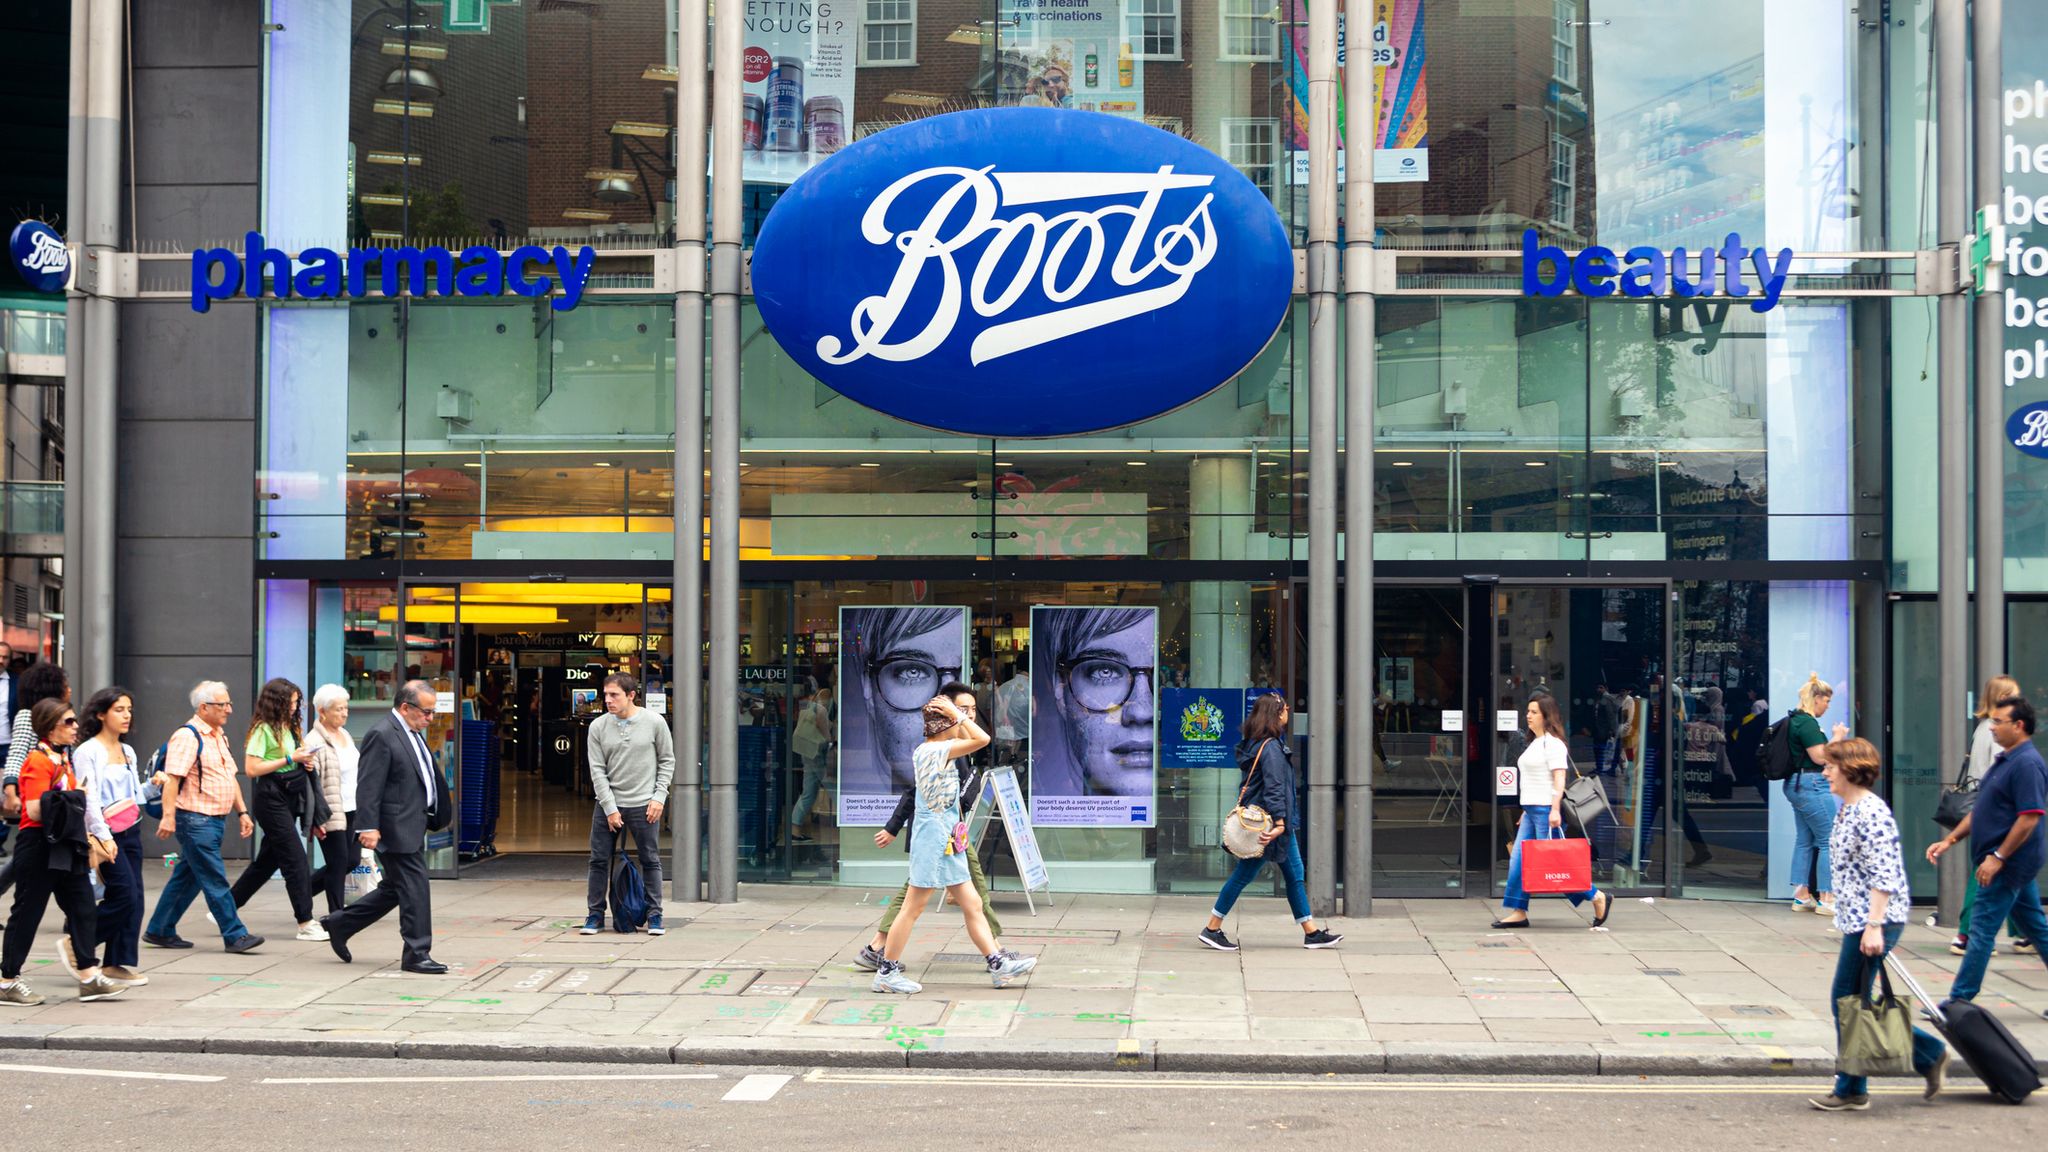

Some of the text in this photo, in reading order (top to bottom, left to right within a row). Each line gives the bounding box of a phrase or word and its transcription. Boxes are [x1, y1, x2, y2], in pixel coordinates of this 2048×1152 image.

[748, 2, 831, 17] ETTING
[1025, 11, 1102, 20] vaccinations
[192, 230, 598, 312] pharmacy
[816, 164, 1218, 367] Boots
[1522, 228, 1793, 313] beauty
[1670, 486, 1742, 506] welcome to
[1673, 535, 1726, 550] hearingcare
[1695, 640, 1738, 653] Opticians
[566, 669, 592, 679] Dio
[745, 668, 786, 679] LAUDE
